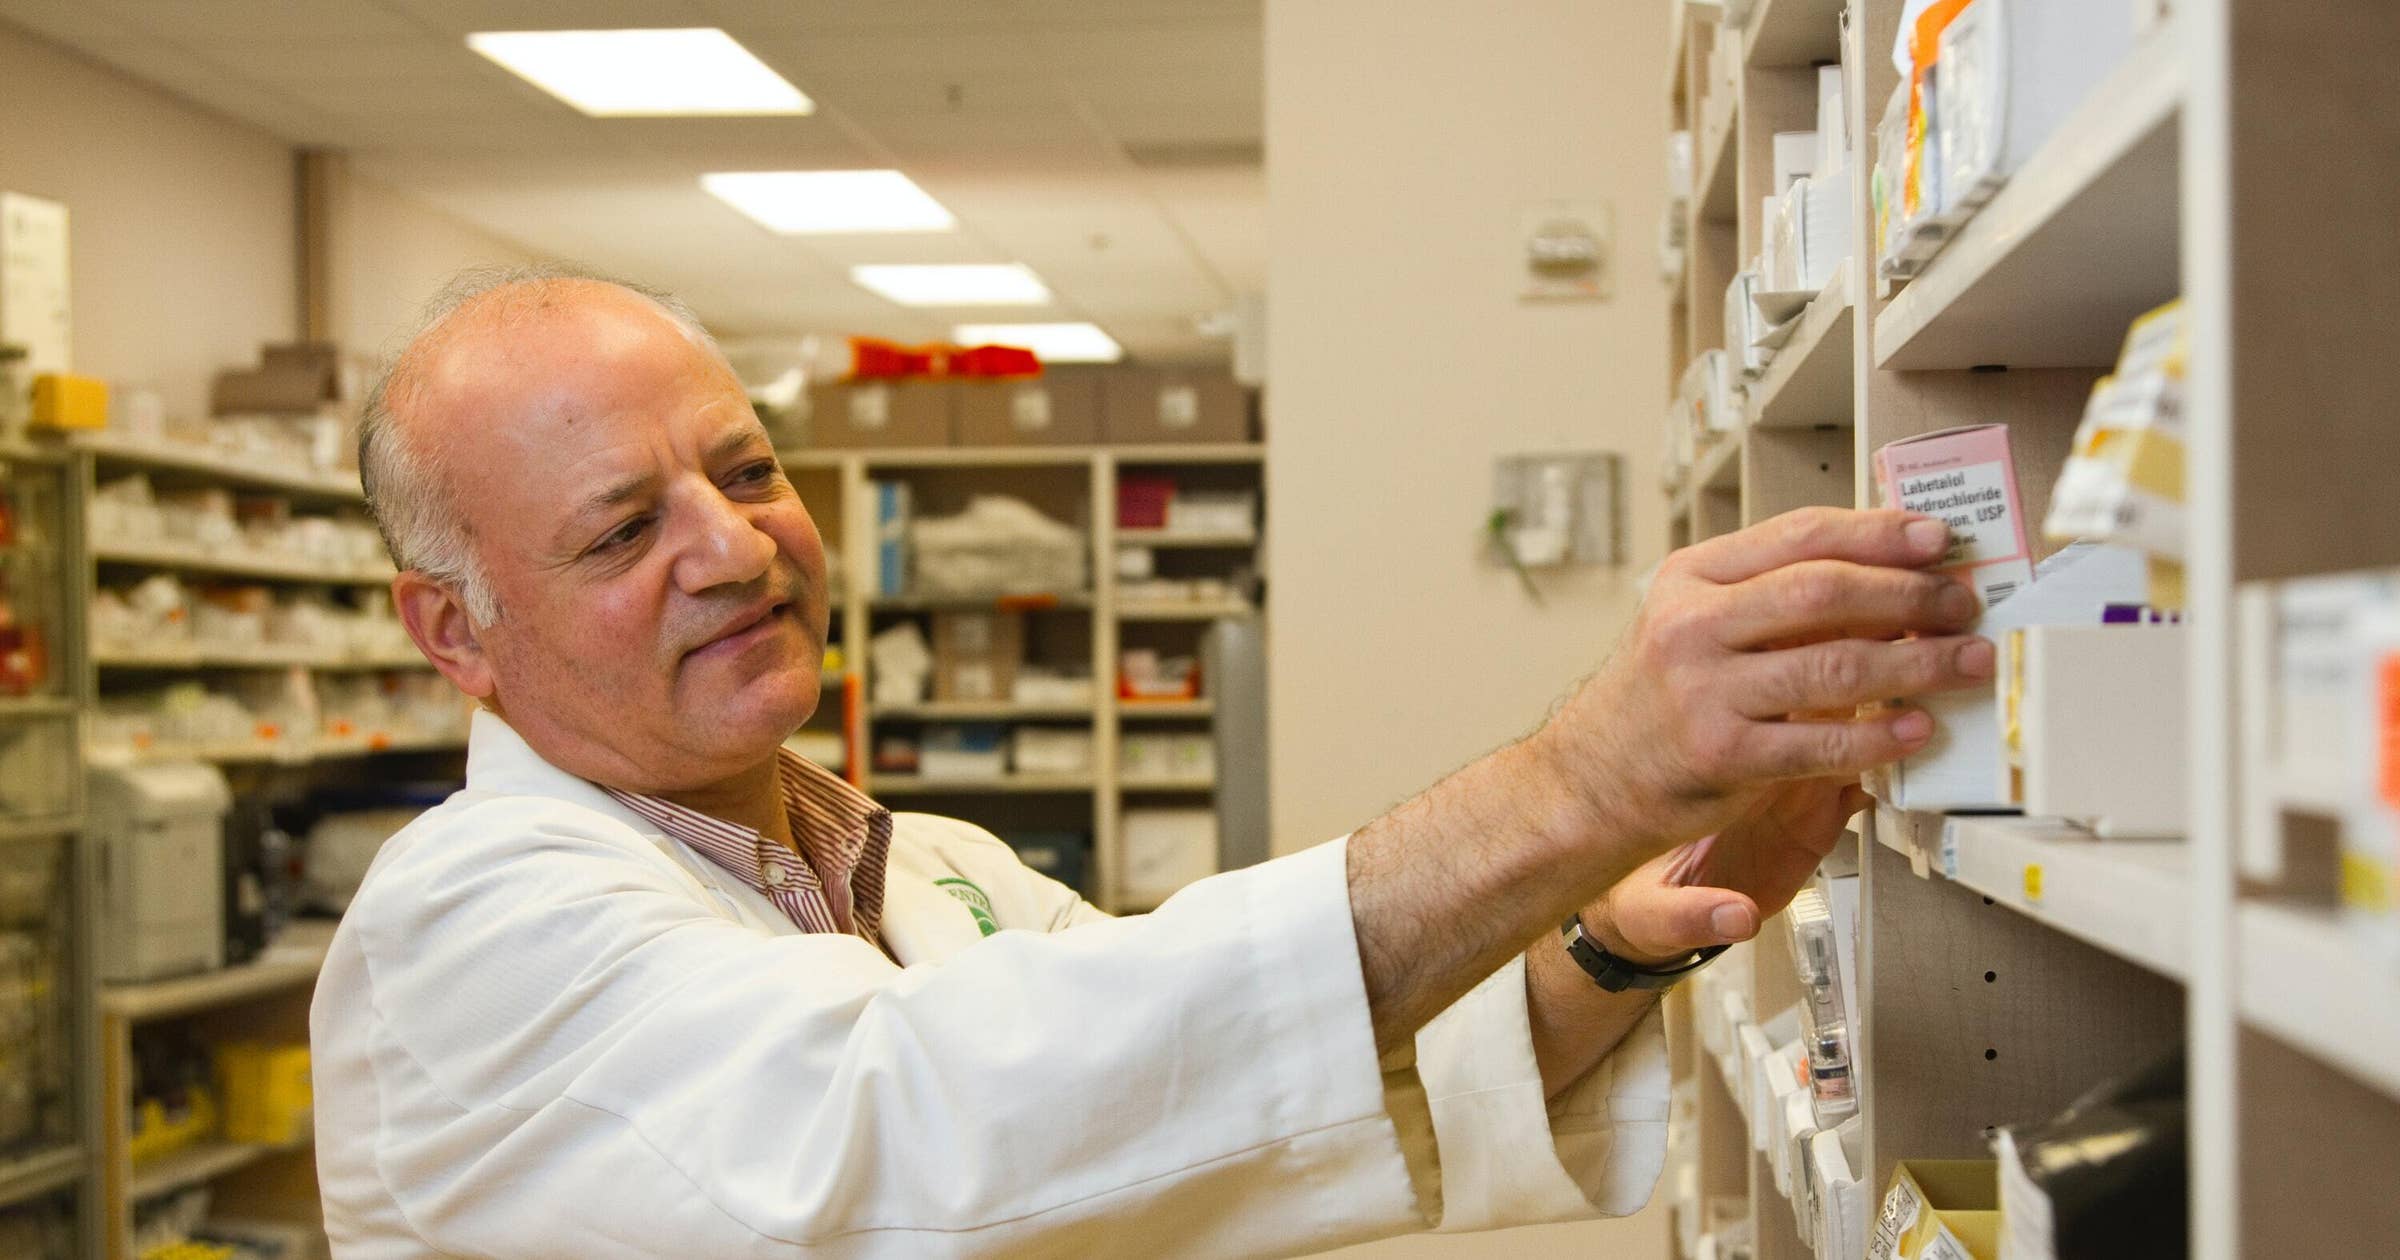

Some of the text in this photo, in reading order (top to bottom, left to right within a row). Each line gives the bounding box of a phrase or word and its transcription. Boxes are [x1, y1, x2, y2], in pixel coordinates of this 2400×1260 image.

[1901, 471, 1965, 496] Labetalol
[1904, 487, 2002, 512] Hydrochloride
[1976, 504, 2006, 521] USP
